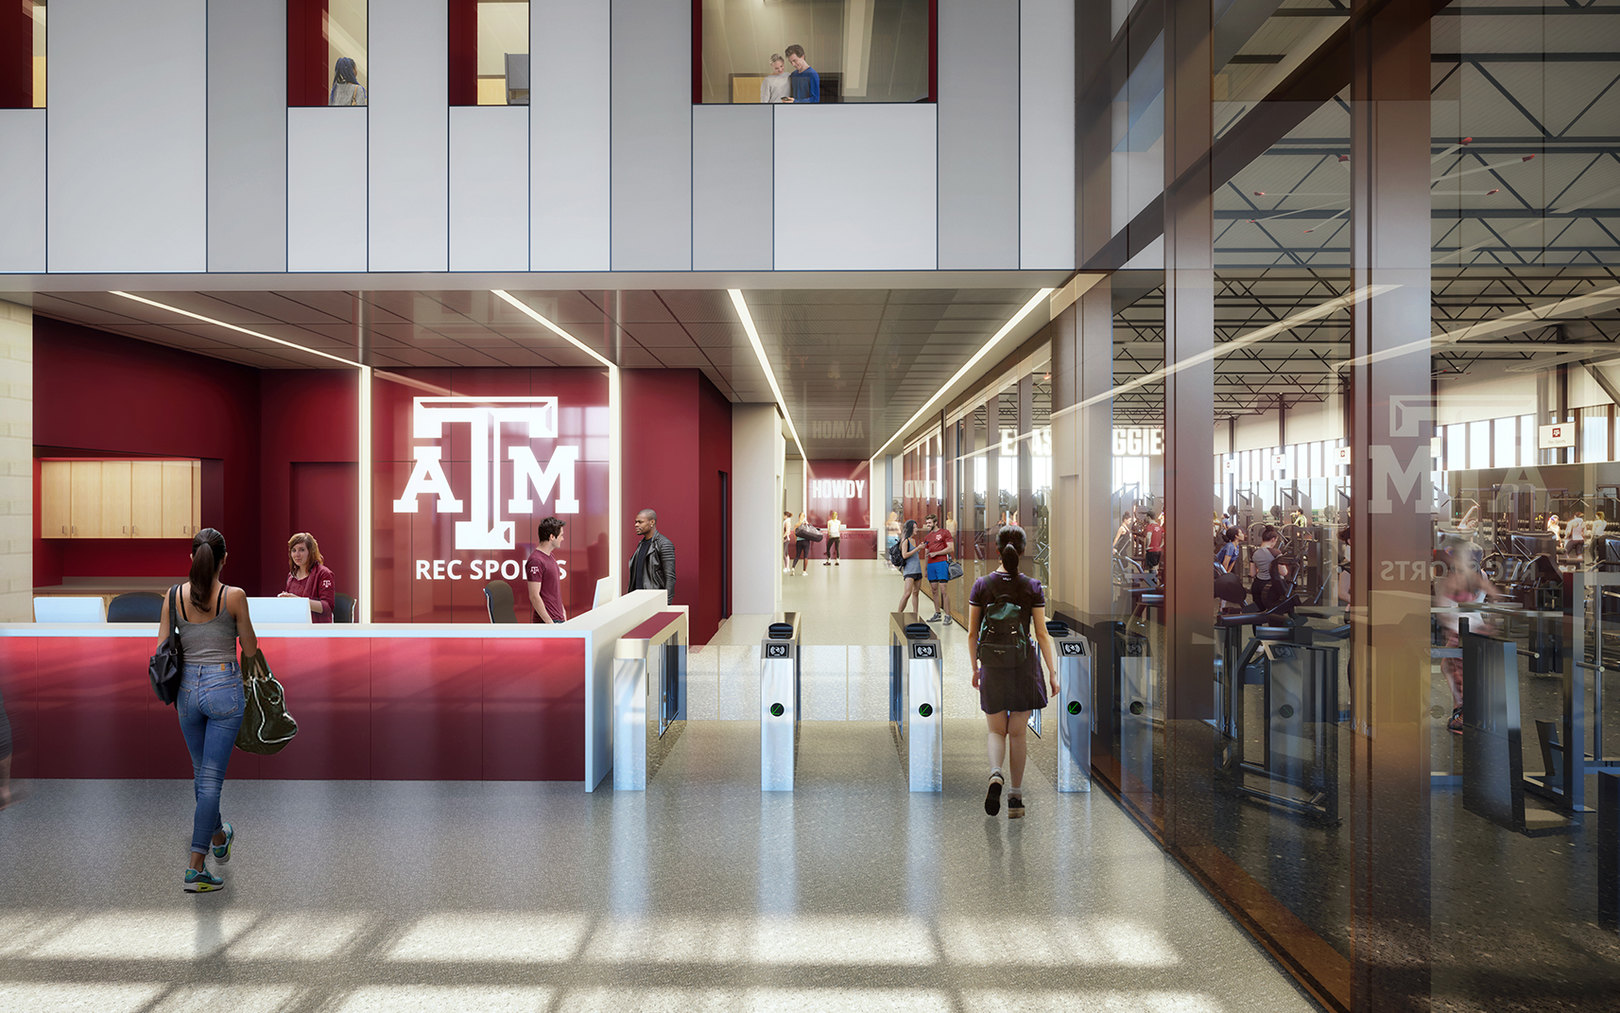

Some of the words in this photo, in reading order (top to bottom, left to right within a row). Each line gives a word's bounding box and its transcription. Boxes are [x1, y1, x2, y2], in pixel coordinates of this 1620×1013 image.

[1112, 429, 1164, 455] GGIE
[812, 479, 865, 498] HOWDY
[415, 560, 462, 580] REC
[470, 560, 567, 580] SPOS
